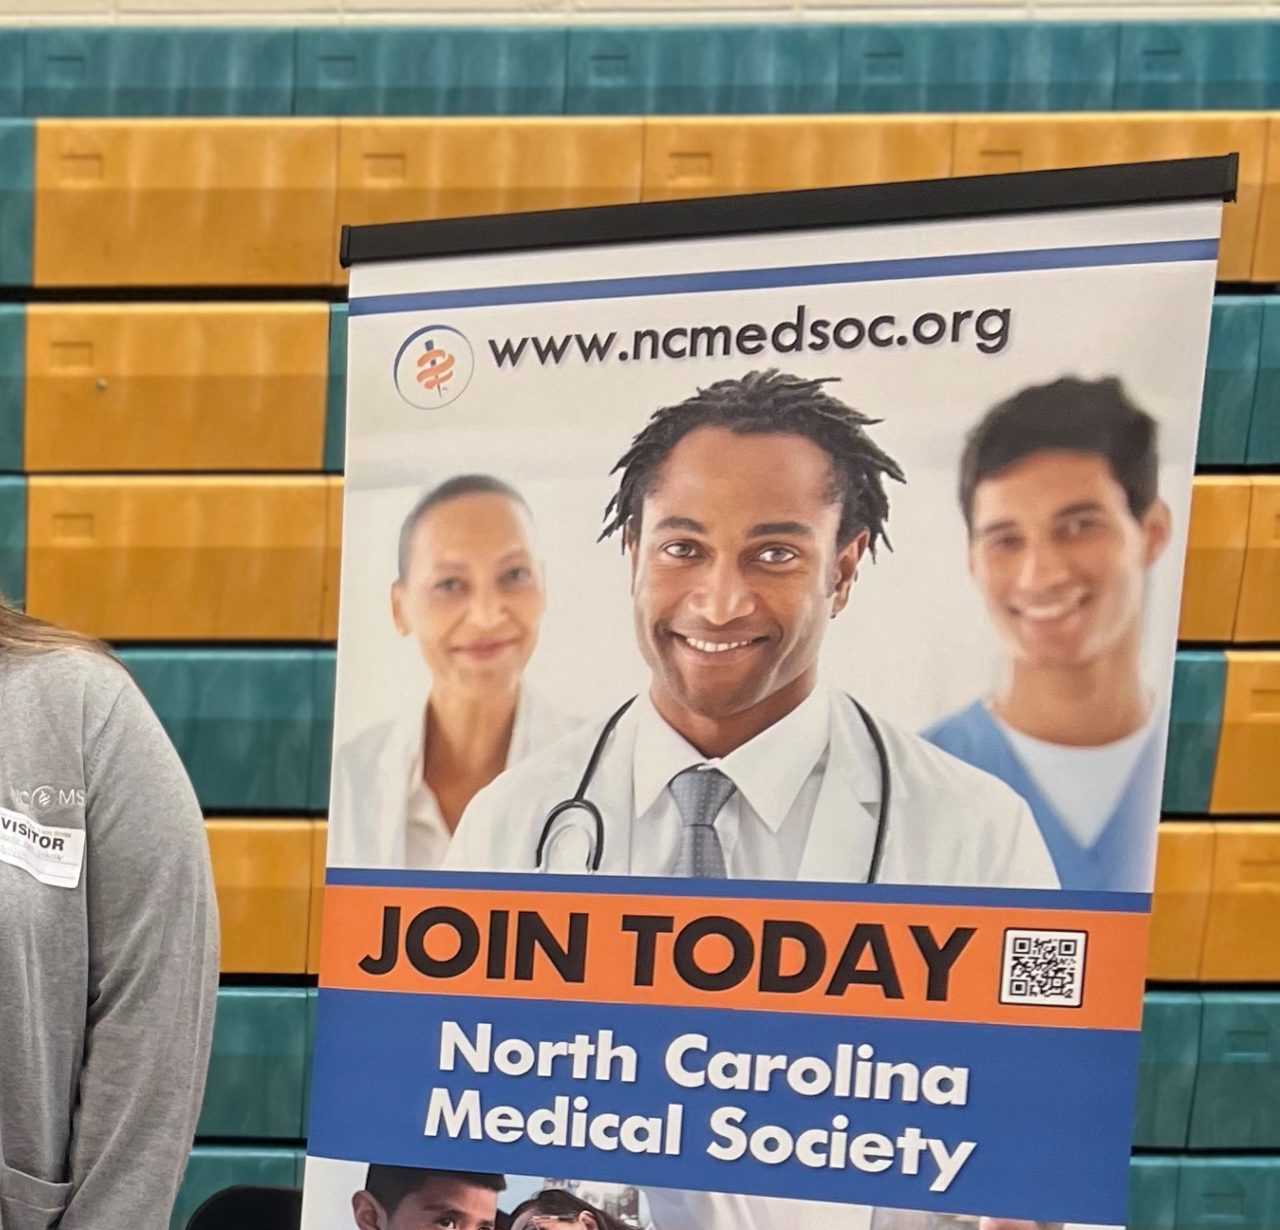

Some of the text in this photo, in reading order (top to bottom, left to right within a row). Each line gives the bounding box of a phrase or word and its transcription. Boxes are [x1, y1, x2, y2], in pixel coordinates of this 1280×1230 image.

[489, 306, 1013, 368] www.ncmedsoc.org
[1, 817, 65, 851] VISITOR
[358, 906, 977, 1002] JOIN TODAY
[439, 1021, 968, 1106] North Carolina
[423, 1089, 977, 1192] Medical Society
